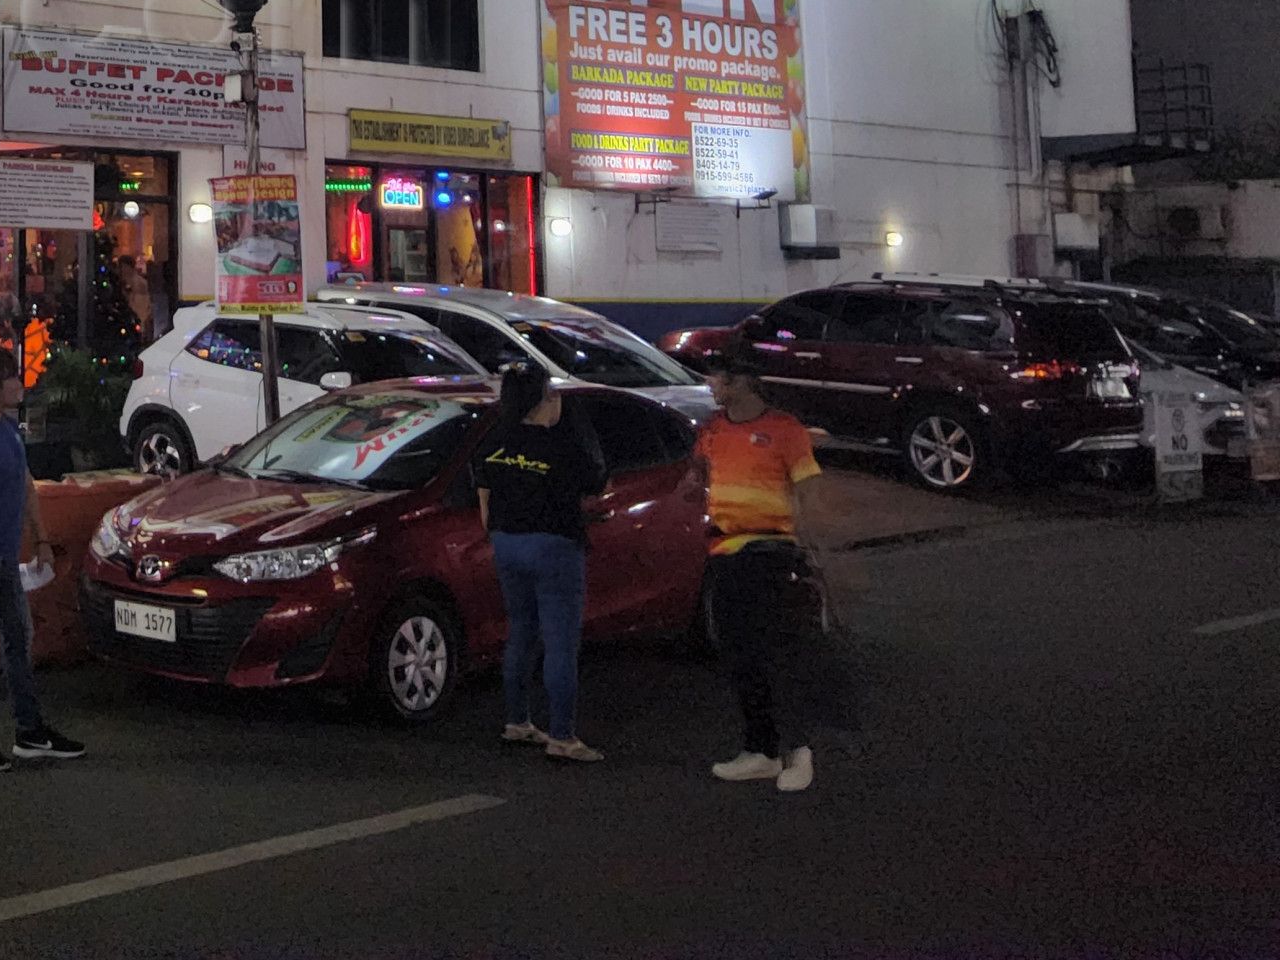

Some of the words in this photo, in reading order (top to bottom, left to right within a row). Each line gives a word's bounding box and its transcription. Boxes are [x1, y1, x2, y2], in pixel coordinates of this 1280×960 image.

[569, 5, 648, 46] FREE
[656, 15, 673, 48] 3
[682, 17, 779, 60] HOURS
[20, 56, 148, 80] BUFFET
[74, 52, 131, 64] Reservations
[133, 58, 149, 66] will
[569, 41, 603, 60] Just
[607, 48, 642, 64] avail
[646, 52, 670, 67] our
[674, 55, 717, 72] promo
[721, 58, 781, 81] package.
[571, 64, 625, 84] BARKADA
[626, 69, 674, 89] PACKAGE
[69, 77, 135, 92] Good
[142, 83, 176, 95] for
[684, 75, 707, 91] NEW
[709, 78, 739, 95] PARTY
[741, 80, 785, 99] PACKAGE
[28, 85, 67, 96] MAX
[70, 88, 81, 97] 4
[85, 90, 132, 101] Hours
[136, 94, 152, 102] of
[156, 95, 220, 108] Karaoke
[604, 89, 623, 102] FOR
[623, 91, 629, 103] 5
[630, 92, 647, 104] PAX
[606, 105, 633, 117] DRINKS
[634, 107, 670, 120] INCLUDED
[720, 99, 736, 112] FOR
[747, 102, 762, 114] PAX
[191, 119, 235, 130] Dessert
[694, 125, 709, 135] FOR
[710, 126, 731, 136] MORE
[571, 132, 593, 148] FOOD
[599, 135, 628, 151] DRINKS
[629, 136, 654, 152] PARTY
[655, 138, 690, 155] PACKAGE
[604, 155, 623, 168] FOR
[623, 157, 634, 169] 10
[635, 158, 652, 170] PAX
[384, 189, 419, 205] OPEN
[1171, 433, 1188, 451] NO
[116, 607, 138, 629] NDM
[144, 612, 173, 635] 1577
